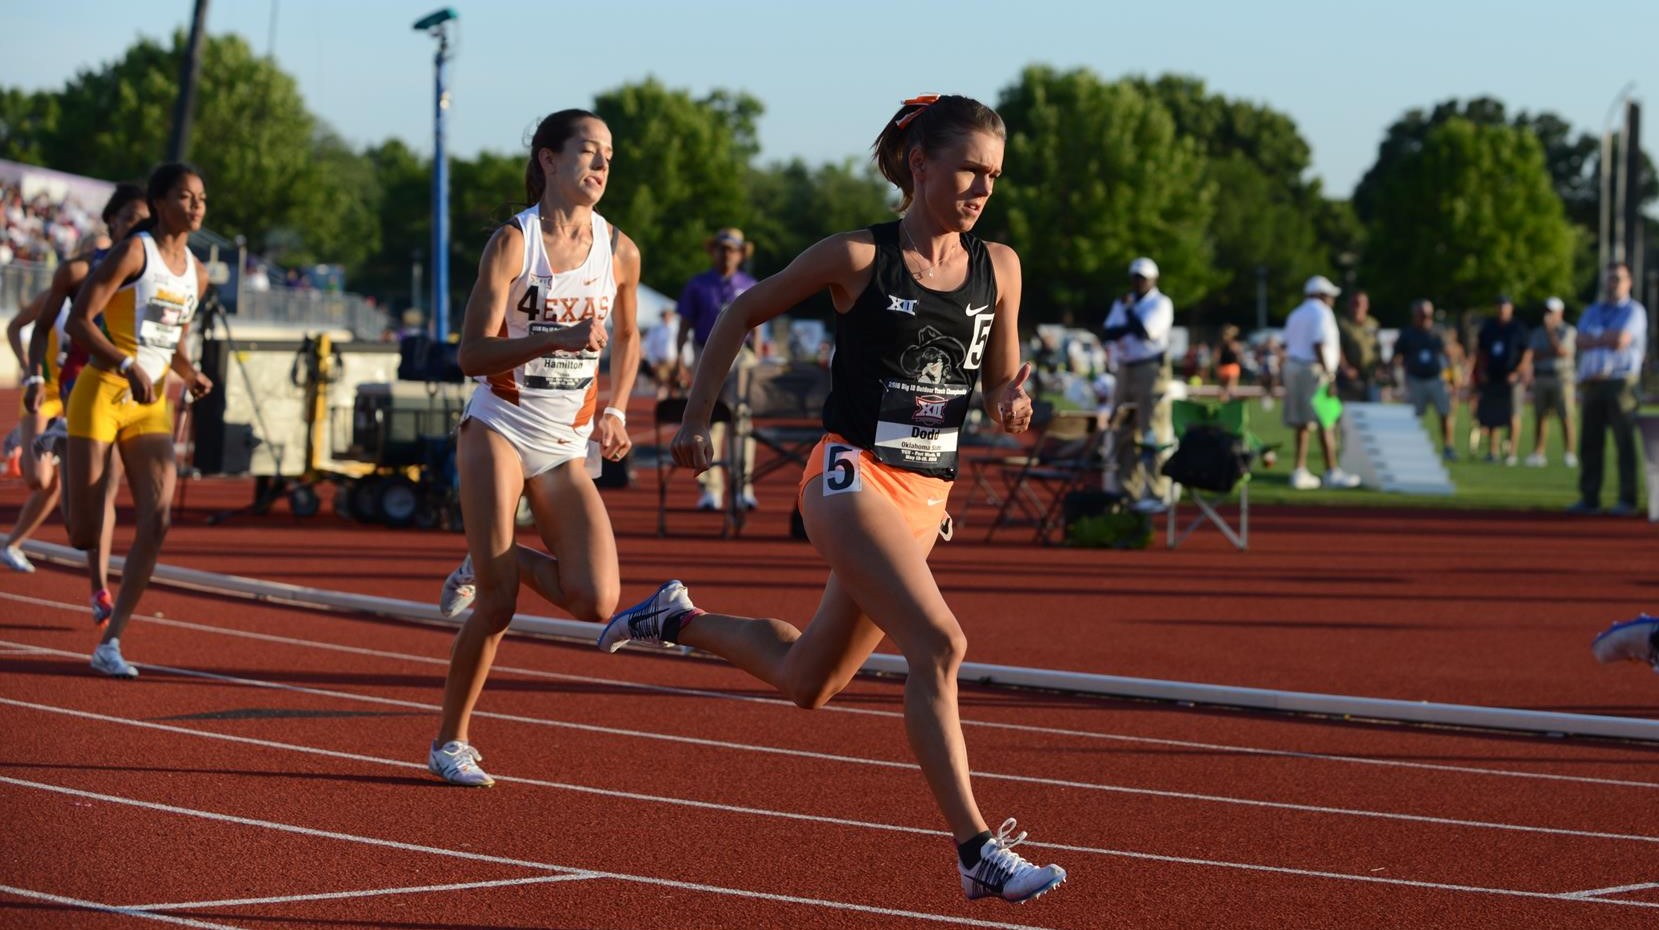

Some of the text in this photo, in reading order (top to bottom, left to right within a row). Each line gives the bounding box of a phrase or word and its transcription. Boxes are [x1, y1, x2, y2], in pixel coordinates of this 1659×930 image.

[517, 285, 540, 321] 4
[543, 296, 609, 323] EXAS
[887, 294, 918, 316] XII
[971, 319, 993, 366] 5
[543, 359, 584, 370] Hamilton
[901, 383, 910, 392] Big
[916, 385, 934, 393] Outdoor
[914, 401, 944, 419] XII
[911, 427, 940, 440] Dodd
[901, 441, 931, 451] Oklahoma
[827, 446, 855, 491] 5
